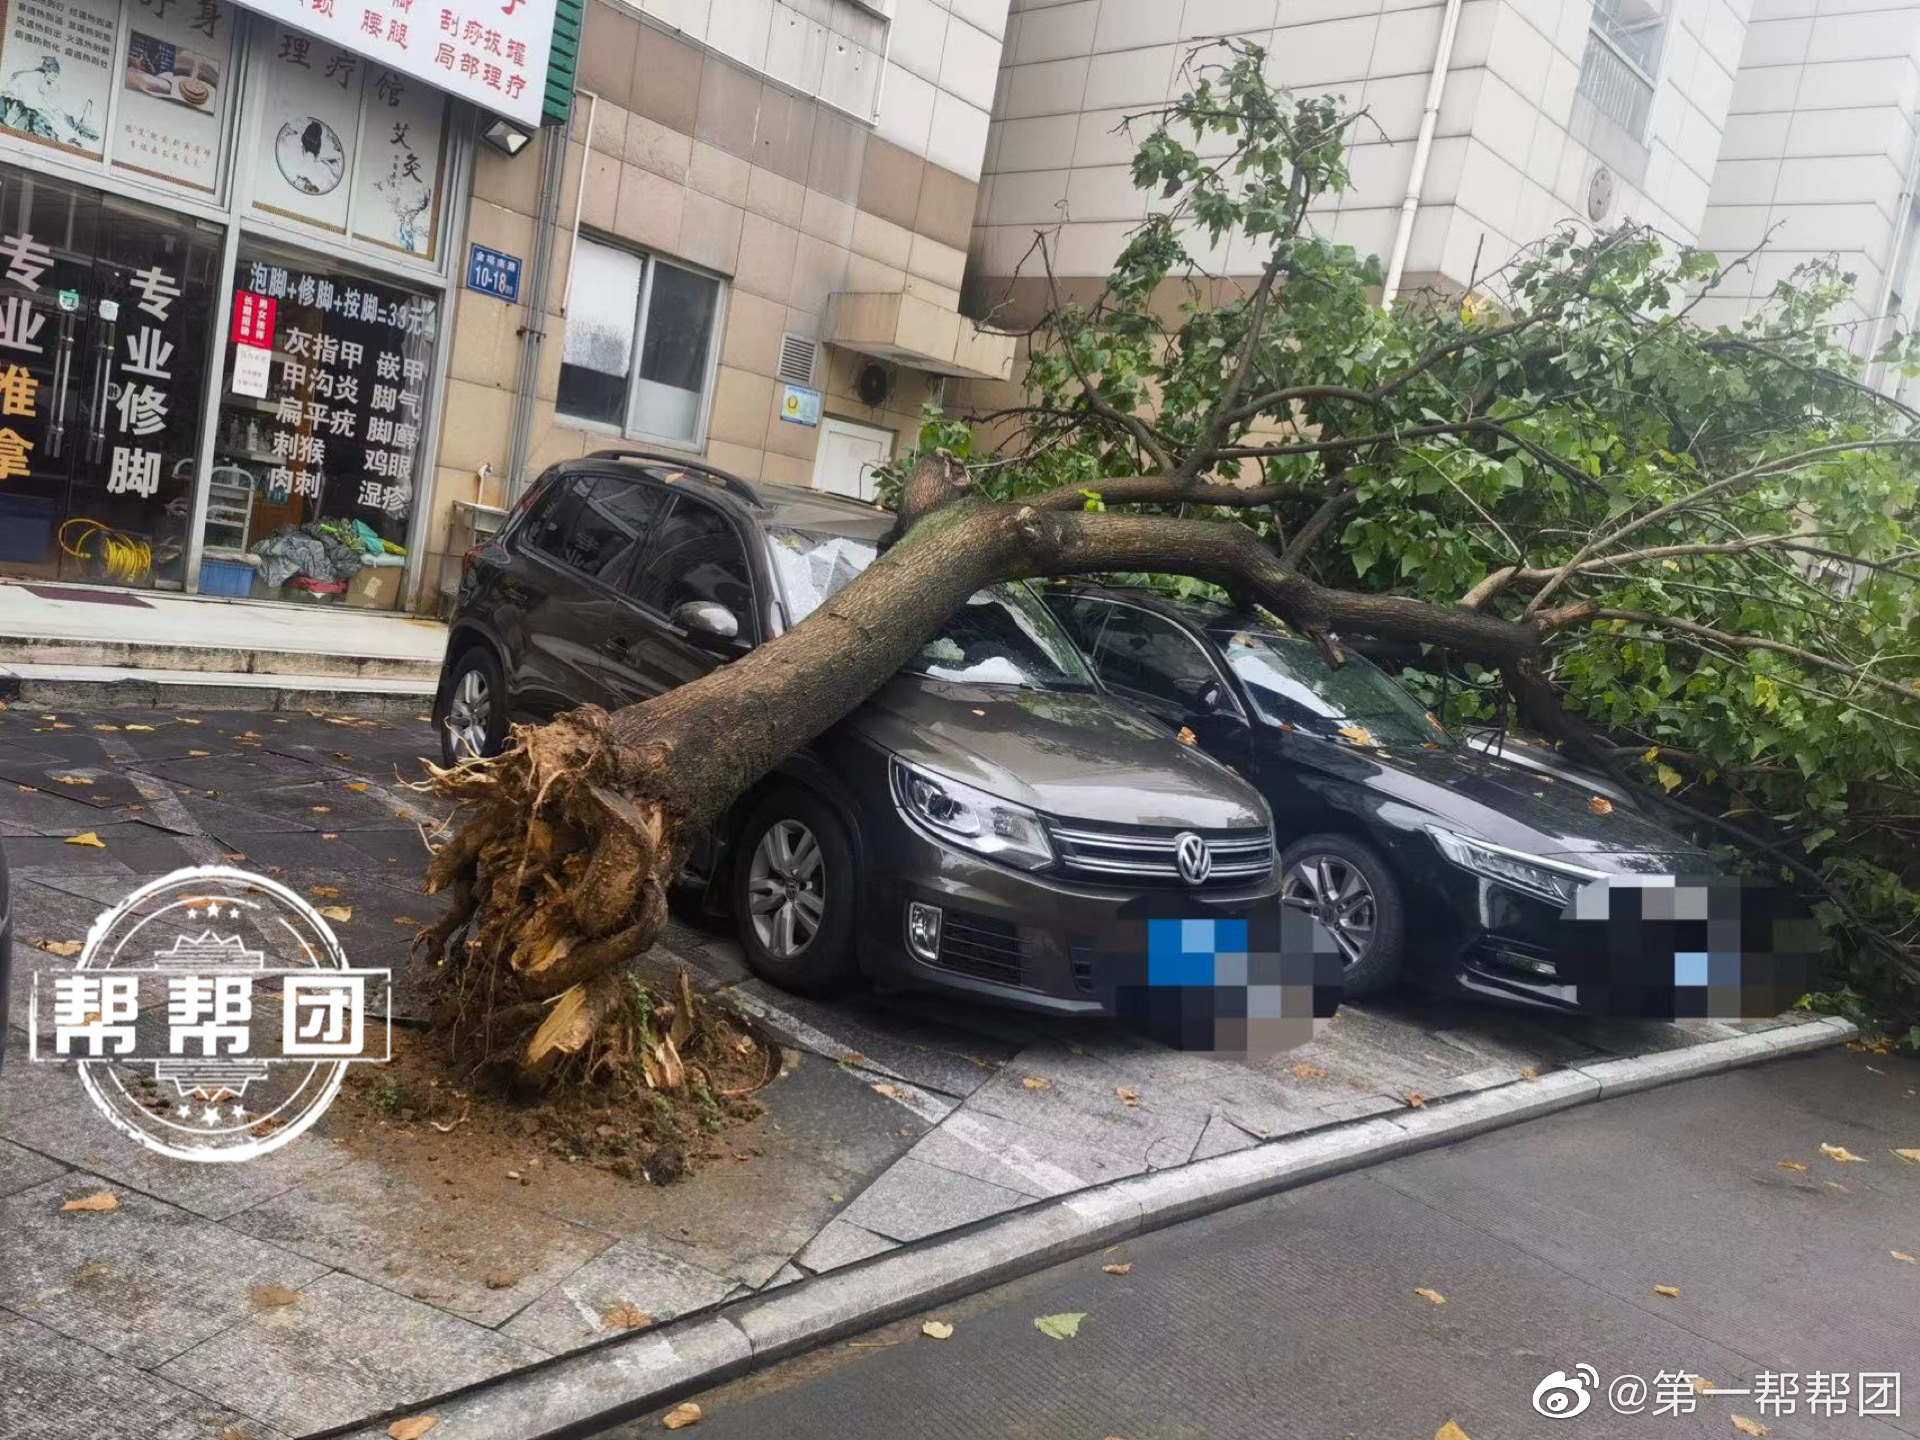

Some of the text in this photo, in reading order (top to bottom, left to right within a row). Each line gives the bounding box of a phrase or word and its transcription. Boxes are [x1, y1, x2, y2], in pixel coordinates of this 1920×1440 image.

[360, 9, 409, 50] 腰腿
[439, 9, 527, 68] 刮痧拔罐
[278, 34, 405, 107] 理疗馆
[435, 42, 527, 100] 局部理疗
[390, 122, 423, 183] 艾灸
[475, 265, 507, 294] 10-18
[284, 326, 364, 370] 灰指甲
[376, 351, 425, 387] 嵌甲
[107, 266, 181, 499] 专业修脚
[282, 361, 359, 404] 甲沟炎
[370, 384, 422, 421] 脚气
[276, 396, 357, 438] 扁平疣
[269, 467, 321, 499] 肉刺
[363, 449, 412, 481] 鸡眼
[357, 480, 405, 512] 湿疹
